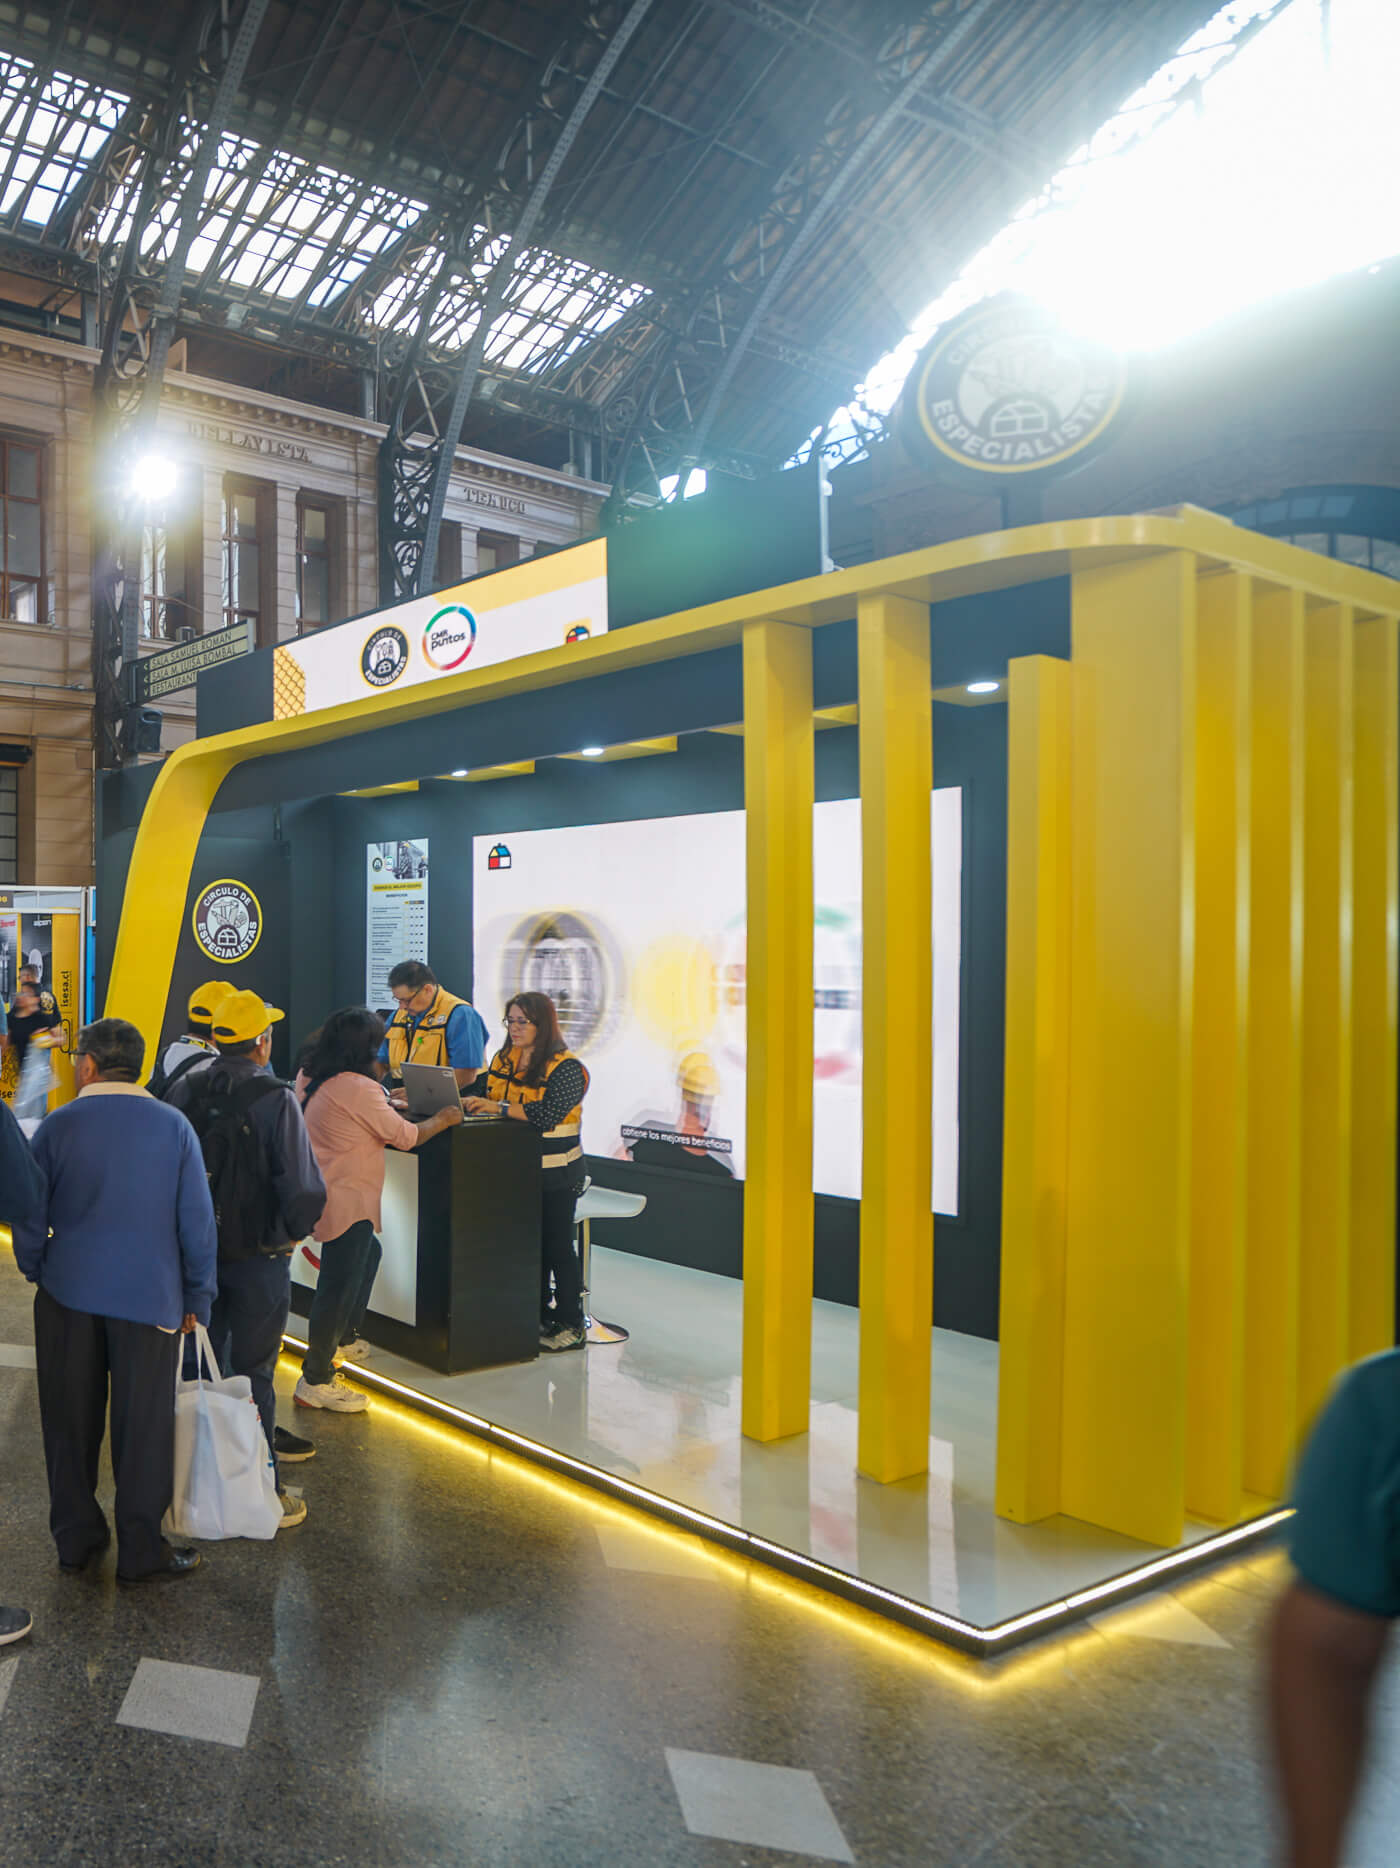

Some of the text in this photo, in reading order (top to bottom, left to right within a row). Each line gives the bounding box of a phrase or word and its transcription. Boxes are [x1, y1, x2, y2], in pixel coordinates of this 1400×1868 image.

[431, 629, 448, 640] CMR
[431, 632, 466, 651] puntos
[151, 632, 233, 668] SALA SAMUEL ROMAN
[151, 668, 169, 680] SALA
[181, 657, 201, 671] LUISA
[203, 646, 236, 663] BOMBAL
[151, 672, 196, 694] RESTAURANT
[203, 887, 252, 906] CIRCULO DE
[198, 921, 257, 958] ESPECIALISTAS
[60, 970, 69, 1008] isesa.cl
[622, 1128, 730, 1151] obtiene los mejores beneficios
